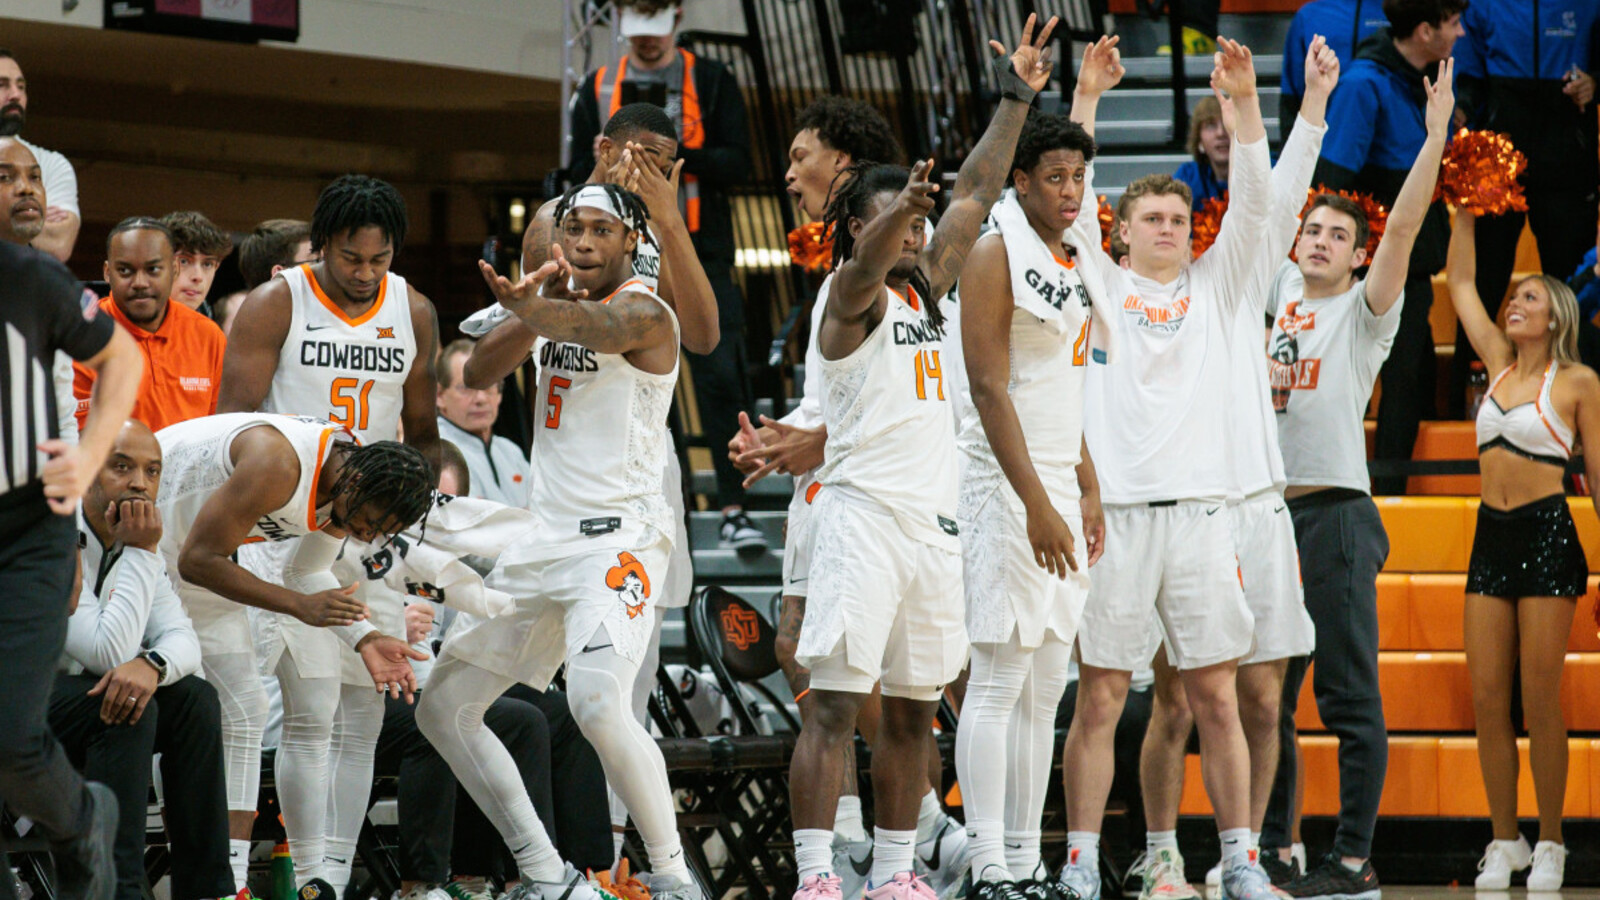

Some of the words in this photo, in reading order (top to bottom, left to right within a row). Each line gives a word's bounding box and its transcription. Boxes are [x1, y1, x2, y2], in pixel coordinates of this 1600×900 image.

[300, 340, 405, 373] COWBOYS
[914, 348, 946, 401] 14
[328, 377, 376, 430] 51
[545, 375, 572, 430] 5
[720, 603, 760, 650] OSU
